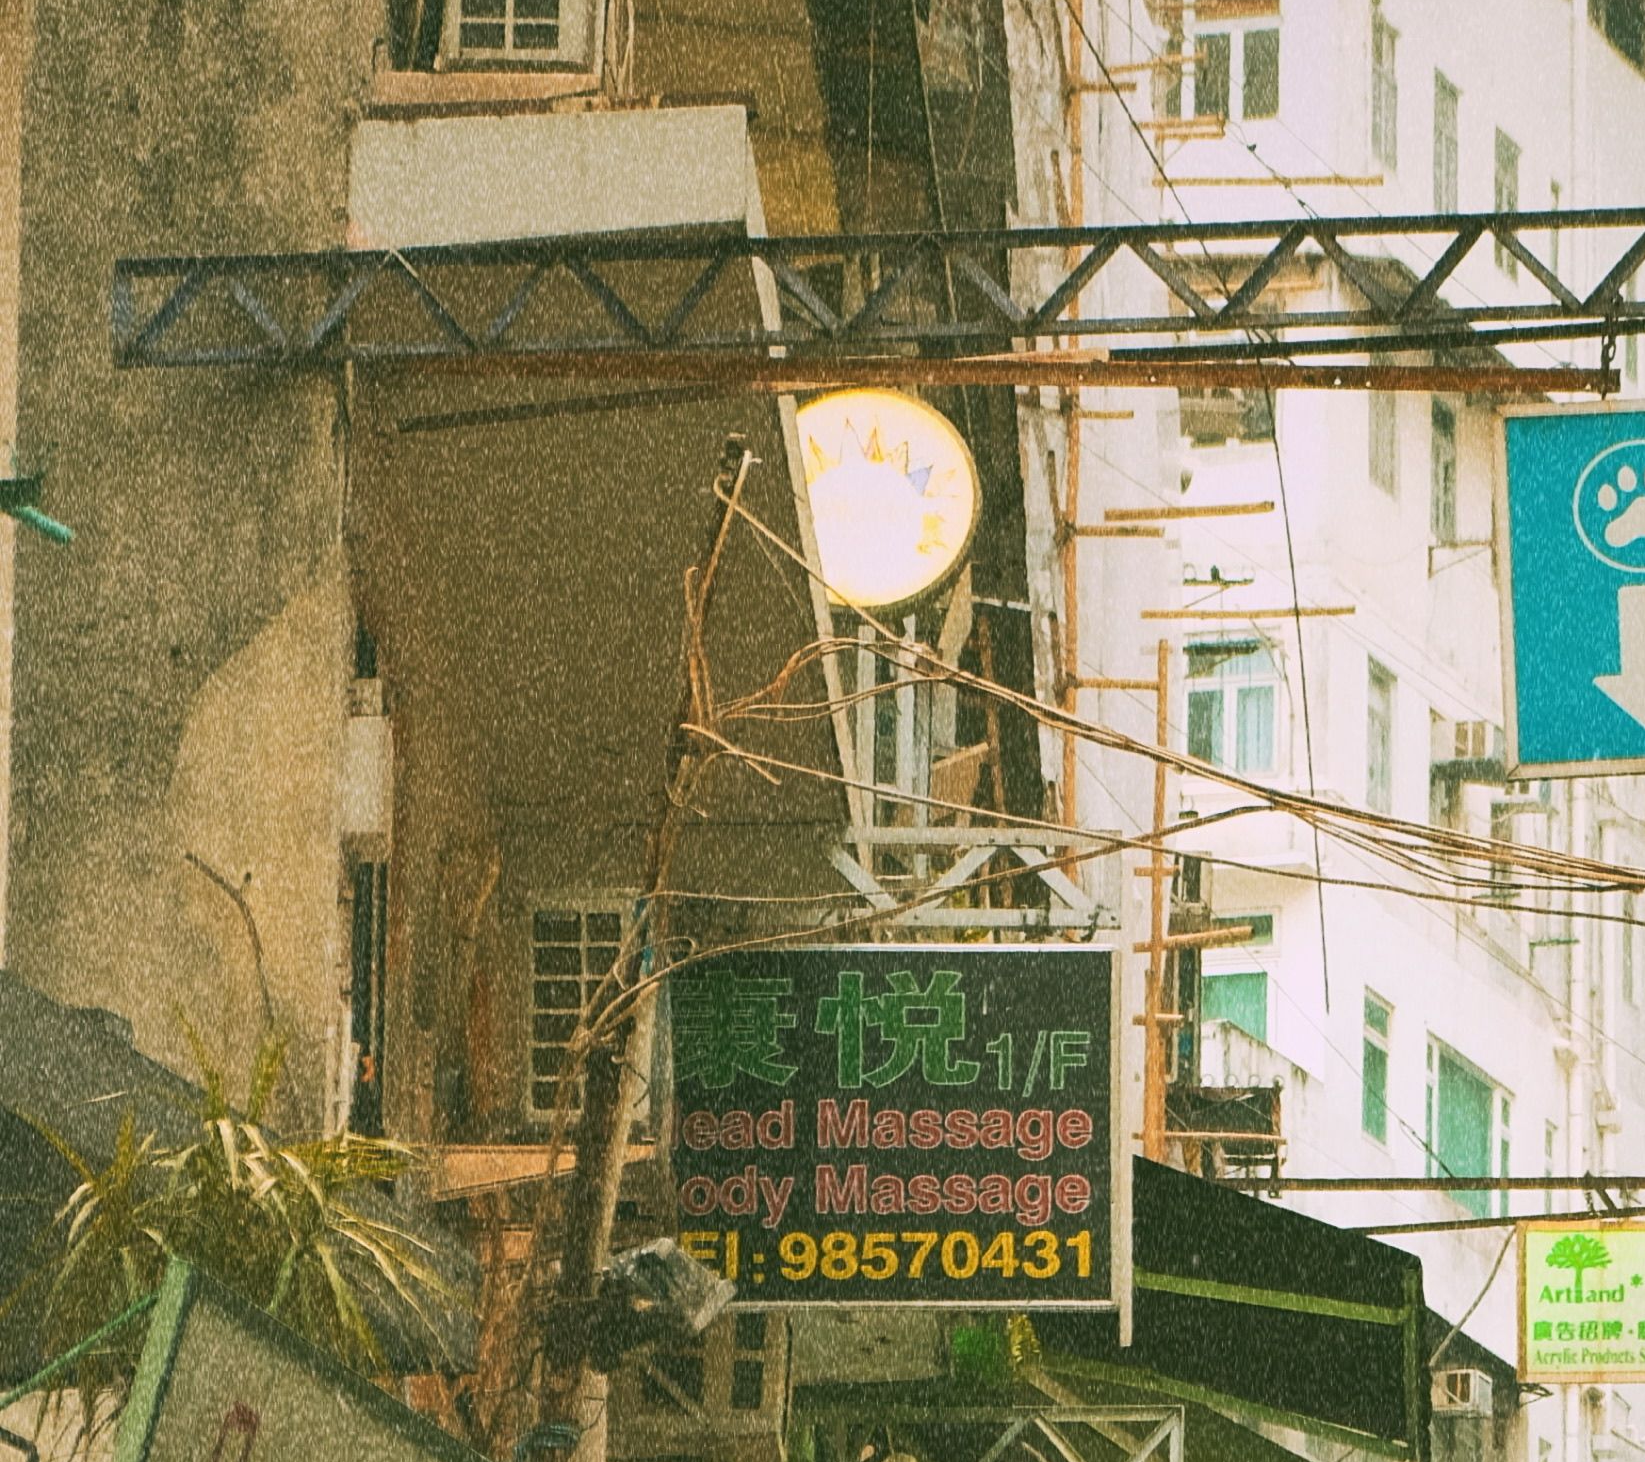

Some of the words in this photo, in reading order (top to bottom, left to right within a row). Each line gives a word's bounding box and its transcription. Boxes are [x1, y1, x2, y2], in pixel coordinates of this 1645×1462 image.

[986, 1031, 1091, 1097] 1/F
[675, 1099, 795, 1150] ead
[817, 1098, 1093, 1161] Massage
[679, 1165, 794, 1229] ody
[815, 1164, 1091, 1227] Massage
[779, 1230, 1092, 1281] 98570431
[1582, 1347, 1635, 1364] Products
